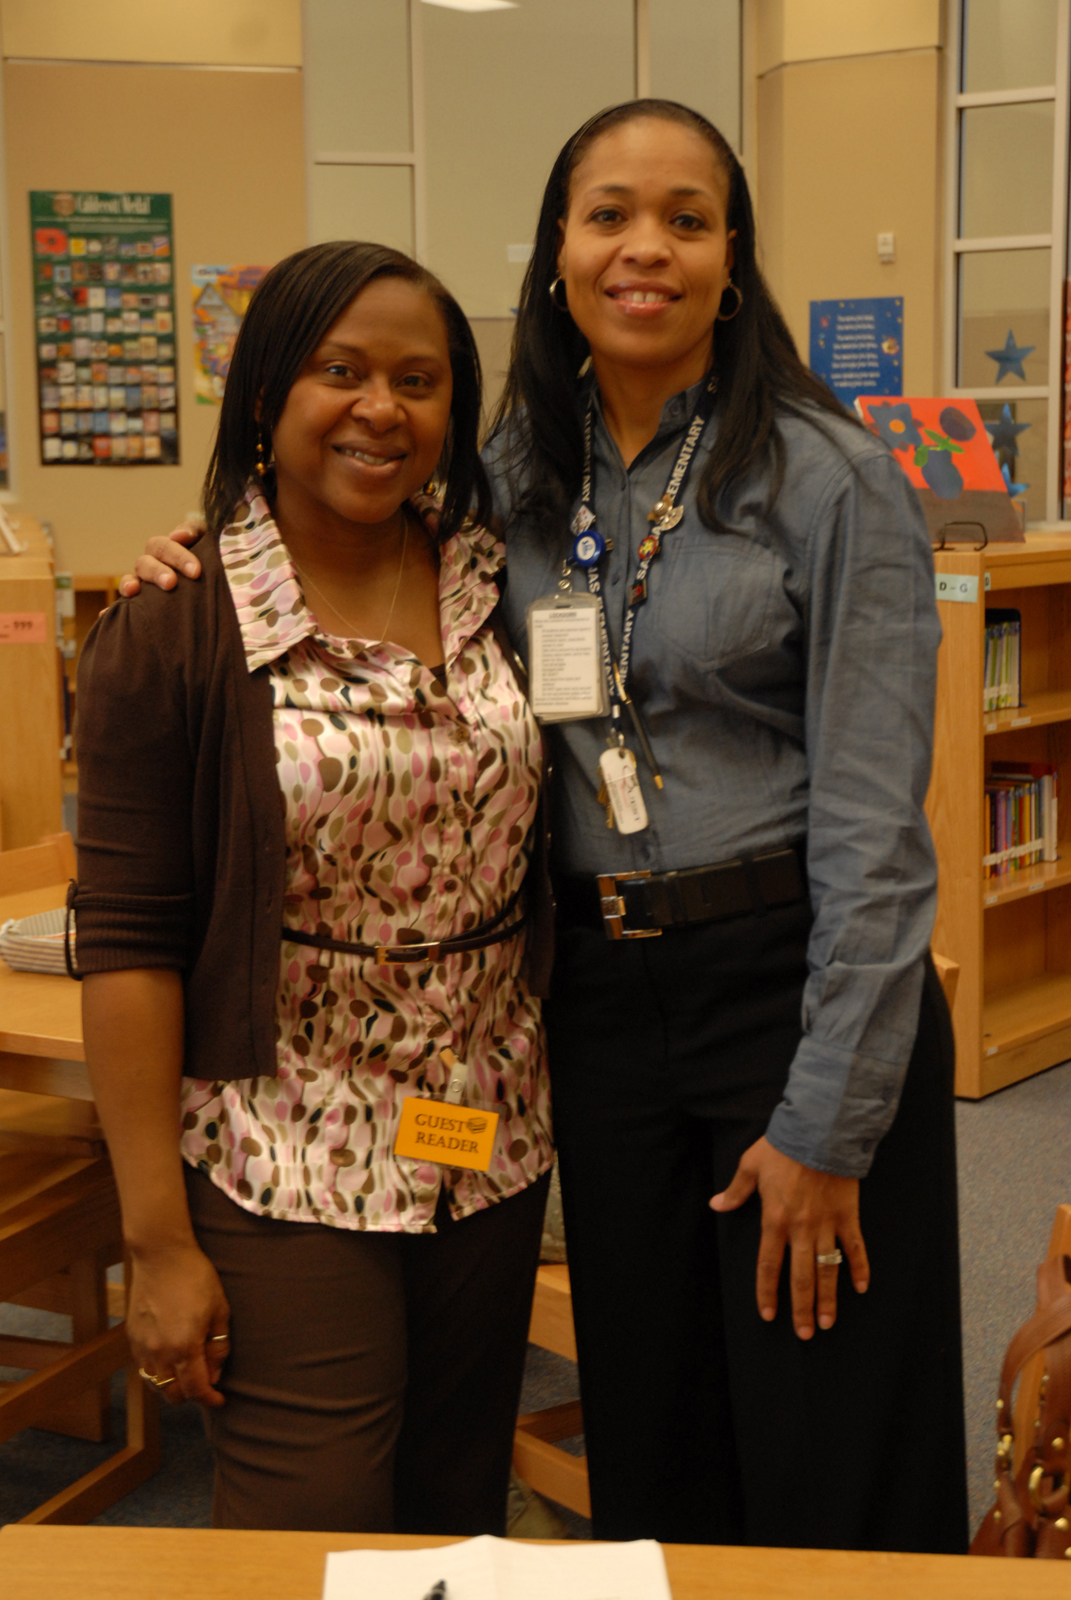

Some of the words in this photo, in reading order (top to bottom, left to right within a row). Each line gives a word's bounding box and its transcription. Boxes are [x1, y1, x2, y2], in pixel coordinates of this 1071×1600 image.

[665, 414, 707, 503] EMENTARY
[939, 581, 947, 591] D
[959, 583, 968, 593] G
[415, 1114, 466, 1132] GUEST
[415, 1131, 479, 1153] READER
